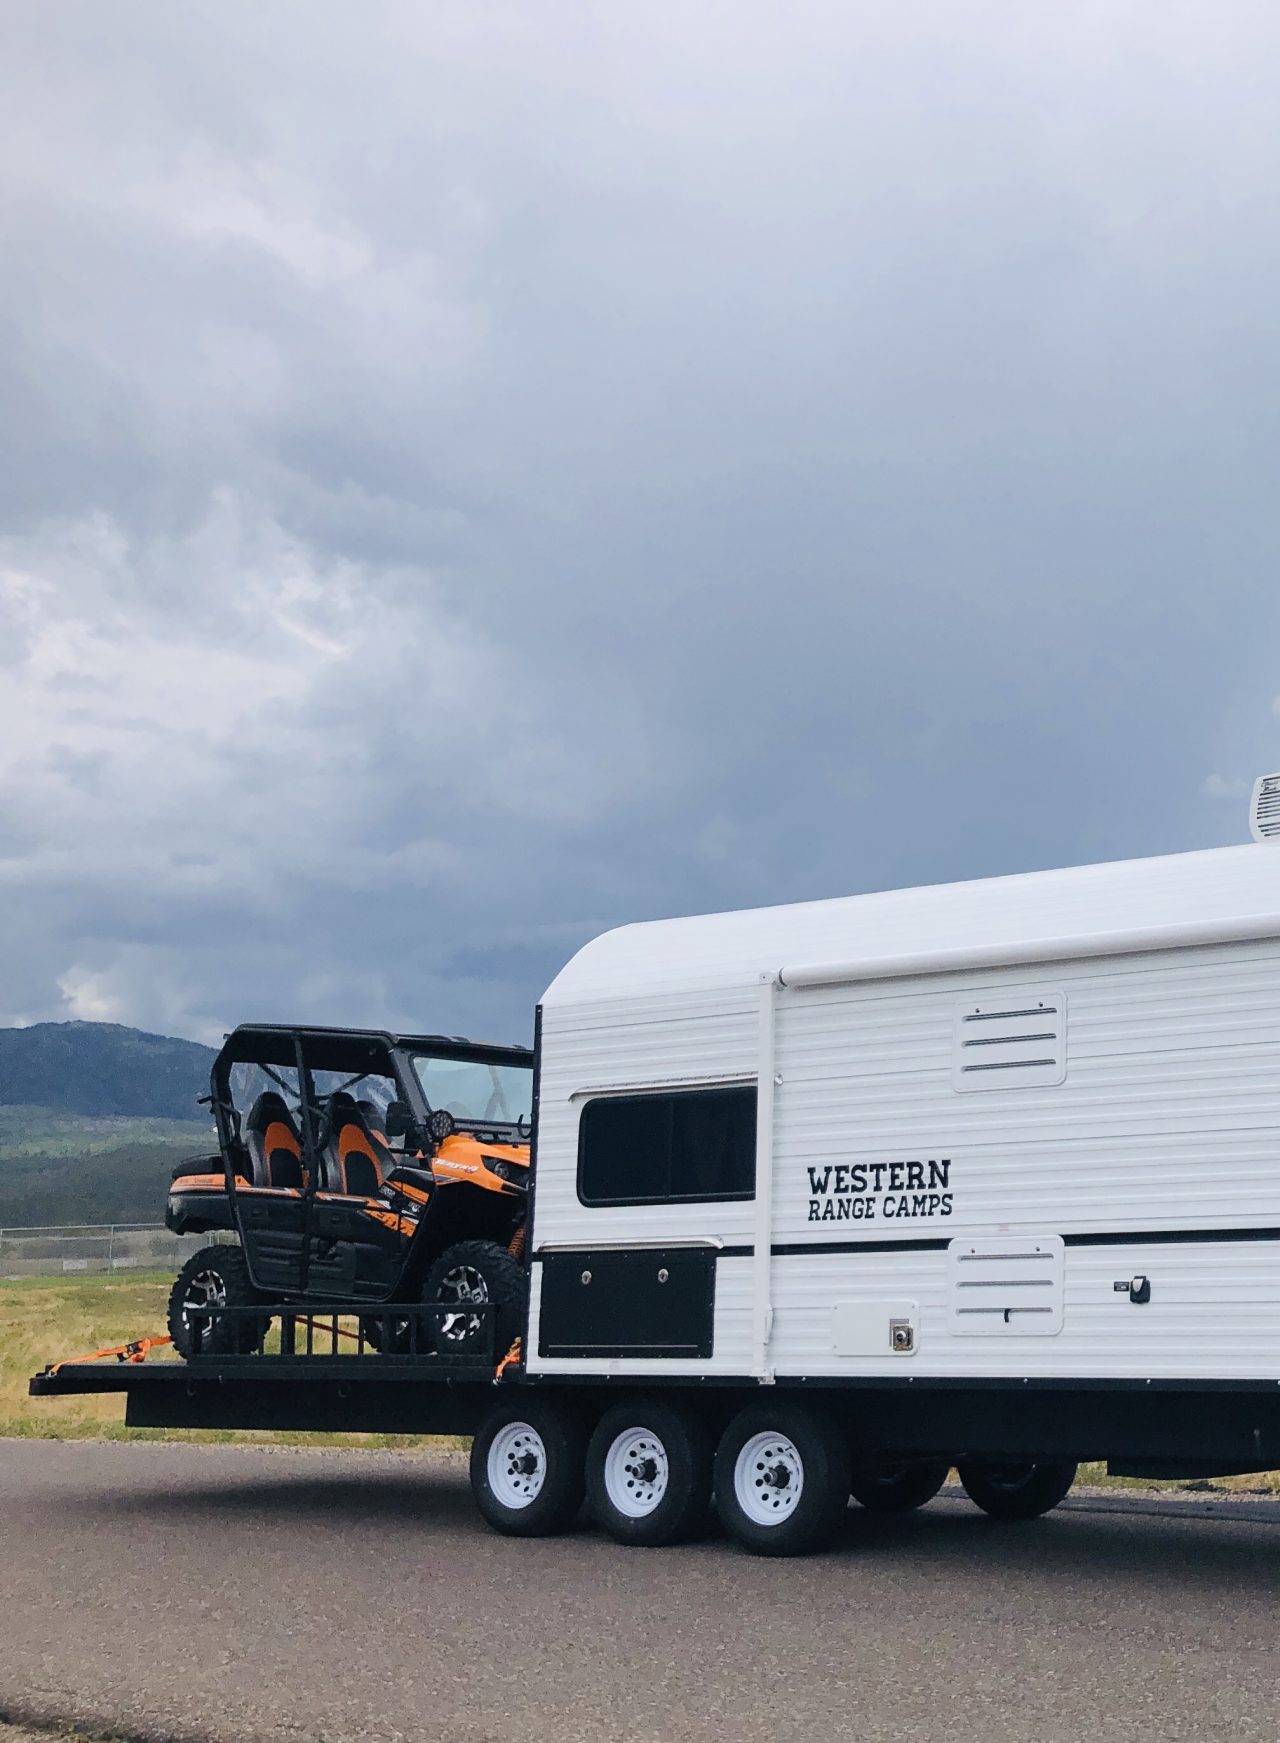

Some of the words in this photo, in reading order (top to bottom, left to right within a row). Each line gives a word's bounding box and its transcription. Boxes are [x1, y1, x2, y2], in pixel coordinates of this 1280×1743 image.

[807, 1160, 951, 1195] WESTERN
[808, 1197, 876, 1221] RANGE
[883, 1193, 953, 1218] CAMPS
